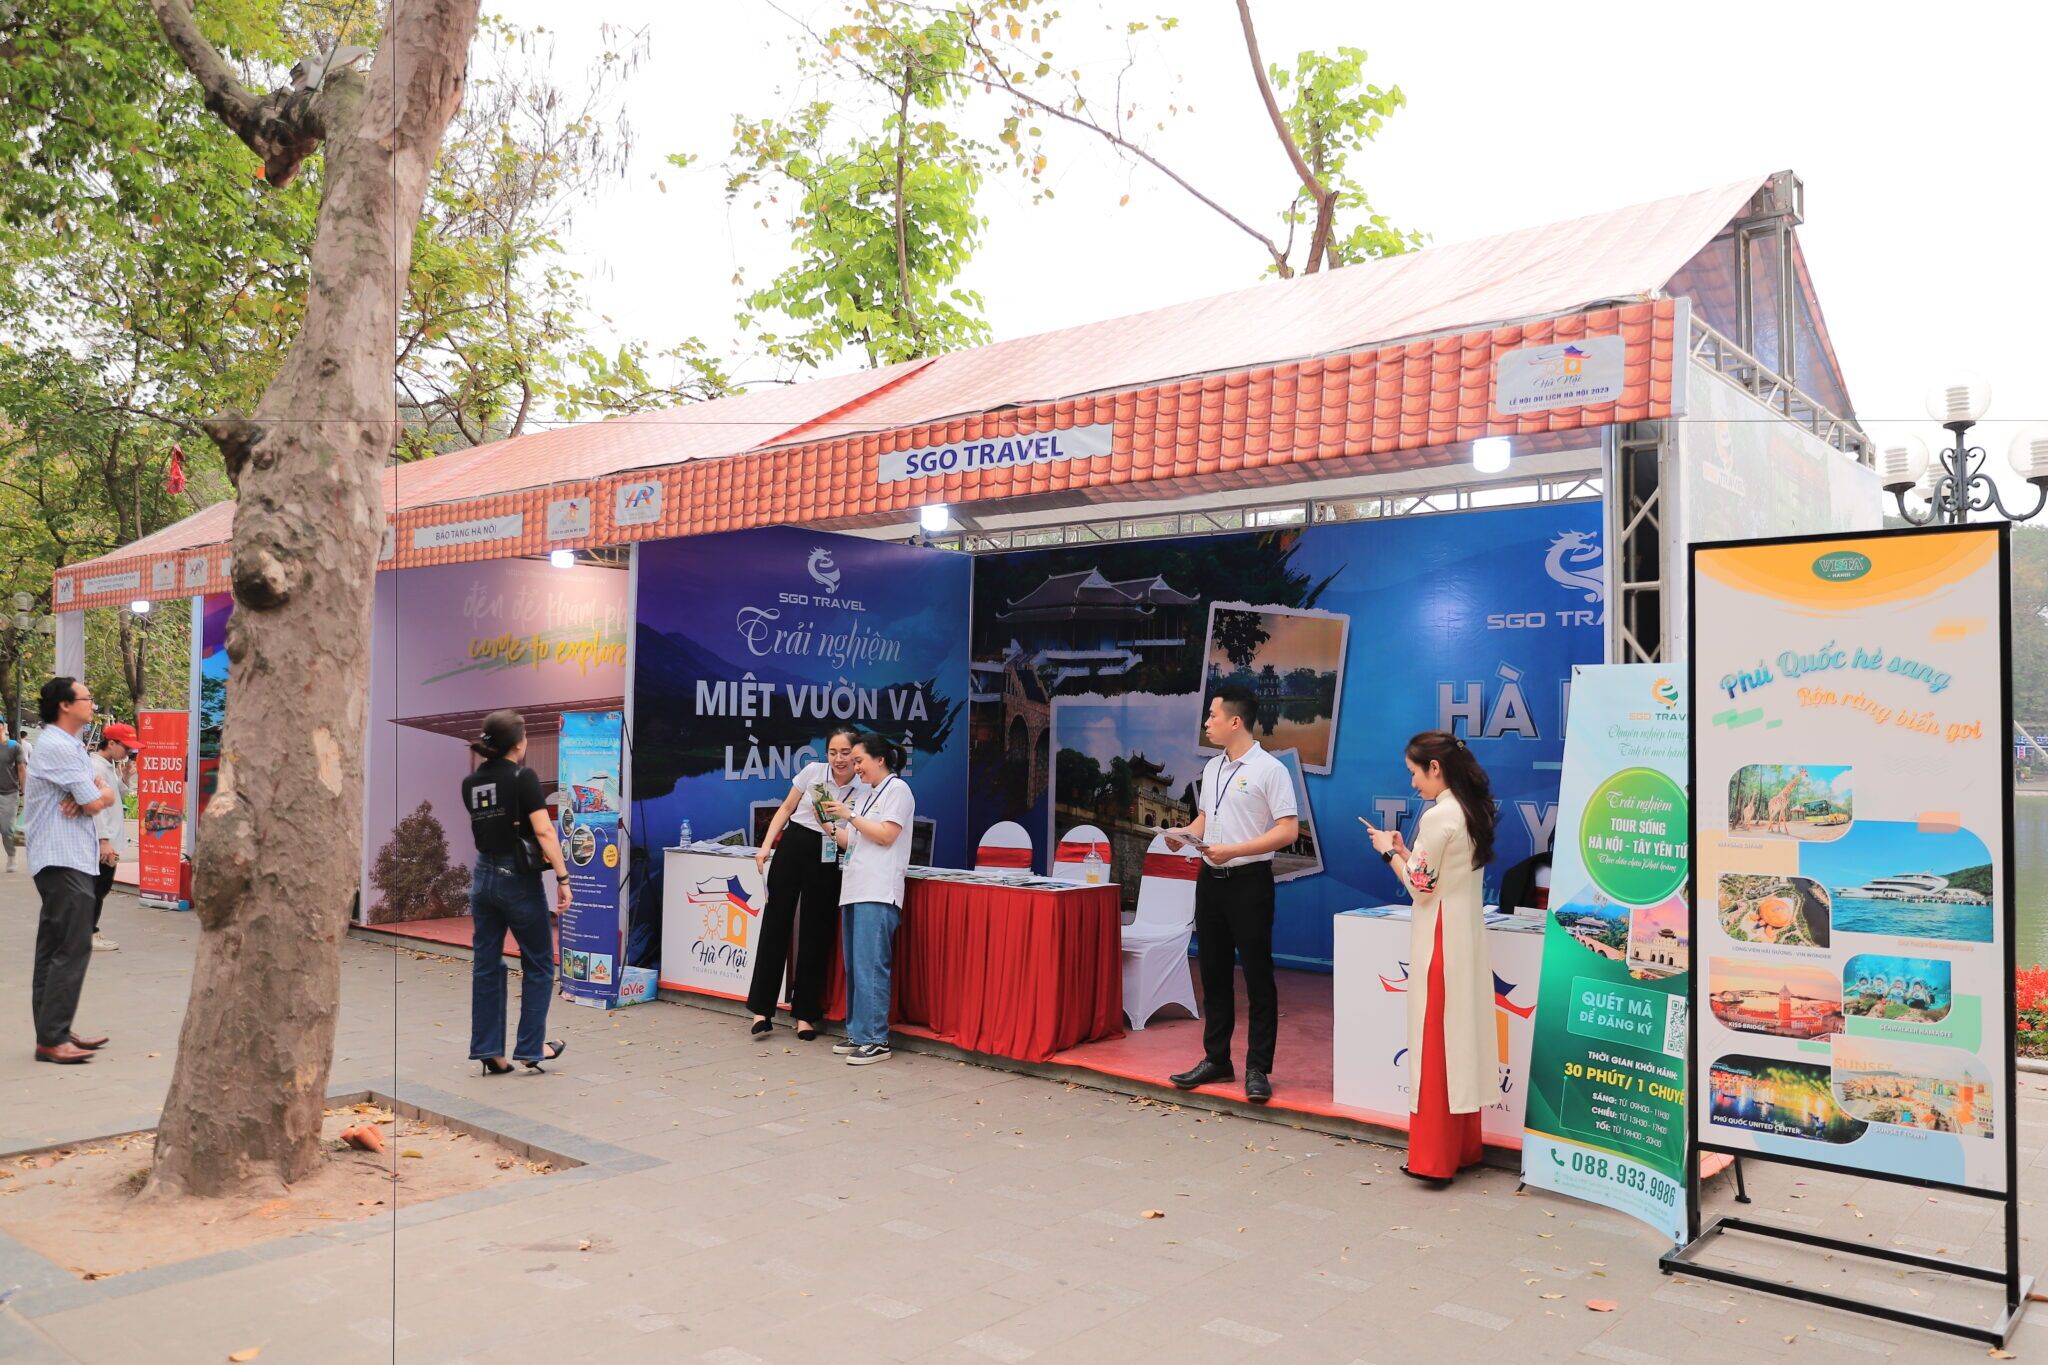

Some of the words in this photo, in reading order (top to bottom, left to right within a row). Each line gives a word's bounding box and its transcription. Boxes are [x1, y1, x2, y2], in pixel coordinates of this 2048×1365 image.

[1591, 387, 1609, 395] 2023
[906, 449, 958, 475] SGO
[964, 436, 1064, 466] TRAVEL
[1819, 557, 1864, 572] VISTA
[779, 592, 808, 606] SGO
[813, 596, 867, 612] TRAVEL
[1487, 612, 1546, 630] SGO
[736, 606, 814, 657] Trải
[818, 618, 901, 670] nghiệm
[531, 633, 549, 672] to
[1776, 640, 1846, 679] Quốc
[695, 671, 775, 728] MIỆT
[786, 676, 878, 720] VƯỜN
[888, 681, 929, 722] VÀ
[1437, 660, 1541, 740] HÀ
[143, 756, 158, 770] XE
[160, 757, 182, 770] BUS
[142, 780, 149, 793] 2
[1610, 817, 1636, 833] TOUR
[1588, 834, 1603, 849] HÀ
[1605, 836, 1623, 853] NỘI
[1633, 838, 1651, 855] TÂY
[1653, 841, 1672, 858] YÊN
[691, 940, 717, 966] Hà
[718, 944, 748, 973] Nội
[1582, 991, 1624, 1012] QUÉT
[1628, 999, 1653, 1019] MÃ
[1579, 1007, 1596, 1023] ĐỂ
[1597, 1014, 1634, 1031] ĐĂNG
[1637, 1021, 1652, 1036] KÝ
[1588, 1051, 1609, 1062] THỜI
[1611, 1056, 1633, 1068] GIAN
[1564, 1062, 1583, 1078] 30
[1586, 1066, 1633, 1090] PHÚT/
[1638, 1078, 1644, 1092] 1
[1592, 1092, 1617, 1105] SÁNG:
[1630, 1103, 1650, 1114] 09H00
[1630, 1115, 1648, 1128] 13H30
[1713, 1114, 1727, 1123] PHÚ
[1728, 1116, 1747, 1127] QUỐC
[1748, 1120, 1773, 1130] UNITED
[1774, 1124, 1801, 1135] CENTER
[1571, 1151, 1676, 1208] 088.933.9986
